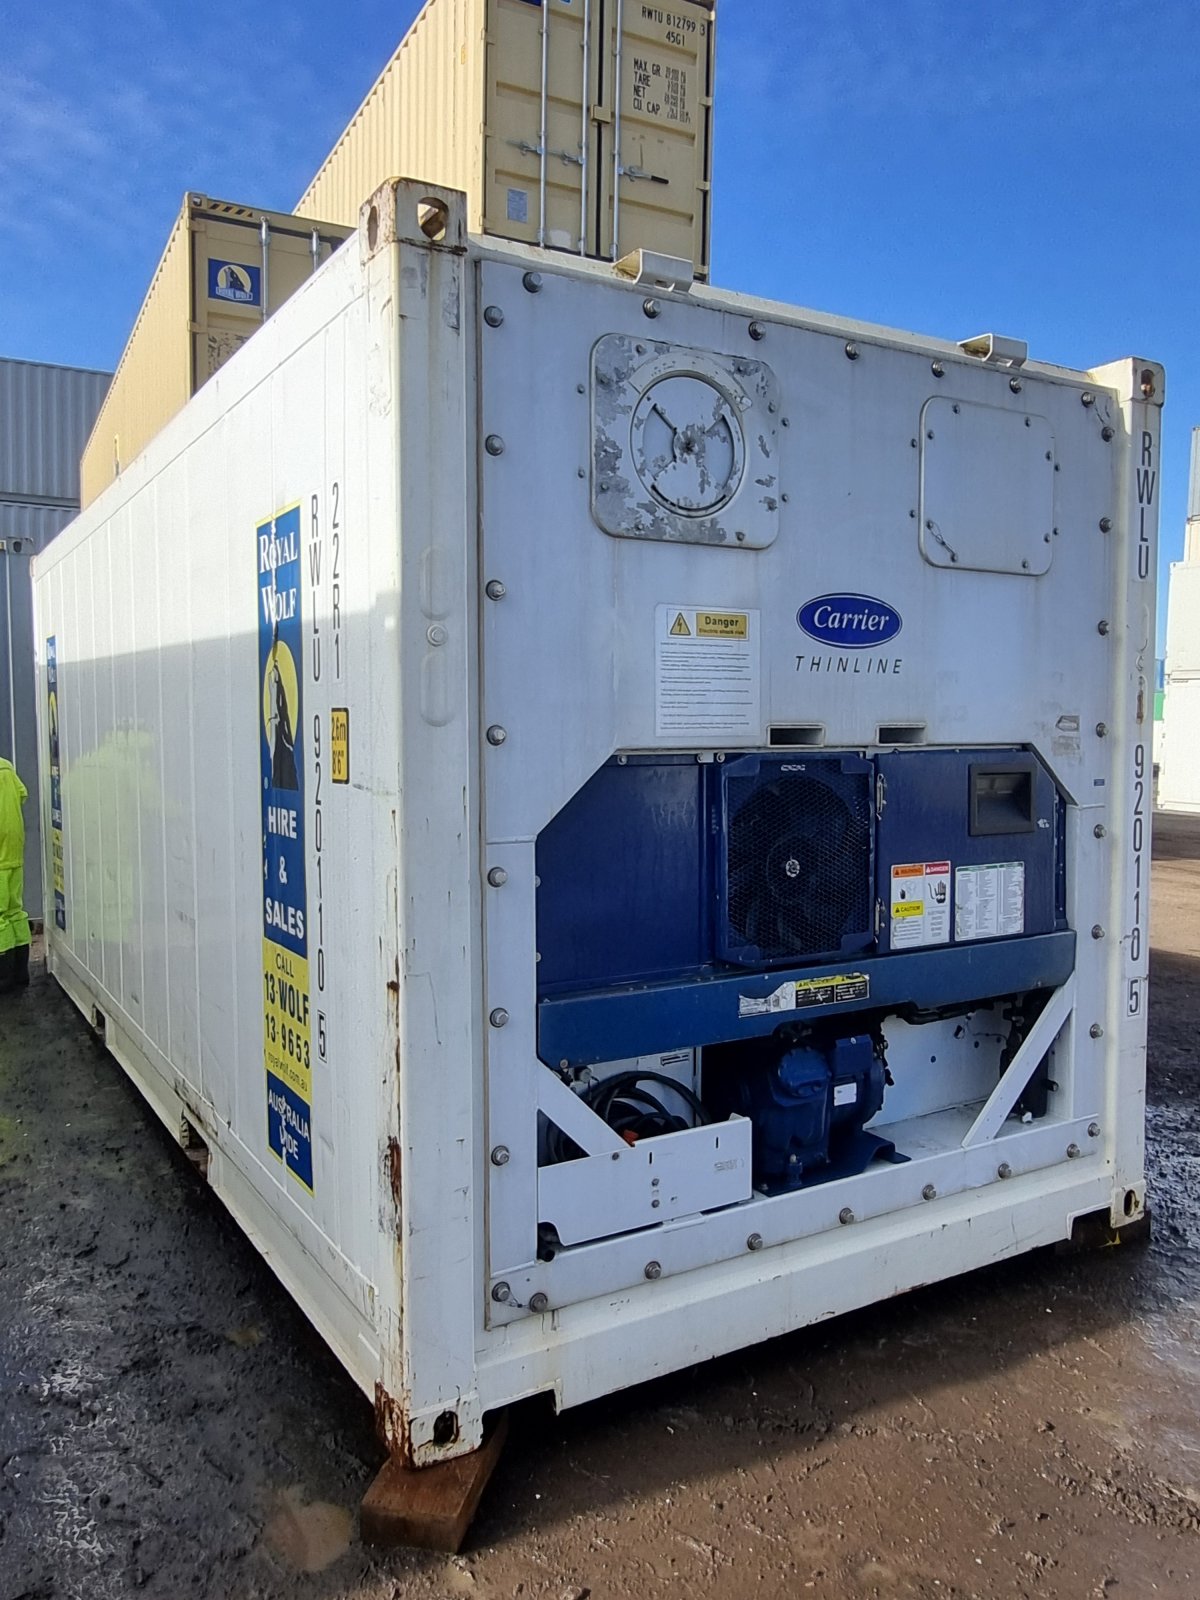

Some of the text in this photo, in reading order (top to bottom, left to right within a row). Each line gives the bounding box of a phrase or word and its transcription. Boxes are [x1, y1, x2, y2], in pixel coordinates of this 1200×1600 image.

[641, 6, 706, 36] RWTU 812799 3
[665, 31, 685, 46] 45G1
[633, 71, 651, 87] TARE
[633, 84, 645, 98] NET
[259, 532, 298, 573] ROYAL
[332, 482, 341, 679] 22R1
[261, 588, 297, 625] WOLF
[814, 605, 889, 631] Carrier
[704, 615, 739, 629] Danger
[796, 655, 902, 674] THINLINE
[1129, 431, 1155, 1013] RWLU 920110 5
[309, 494, 326, 1057] RWLU 920110 5
[268, 806, 297, 839] HIRE
[279, 855, 287, 884] &
[265, 897, 304, 940] SALES
[275, 952, 294, 978] CALL
